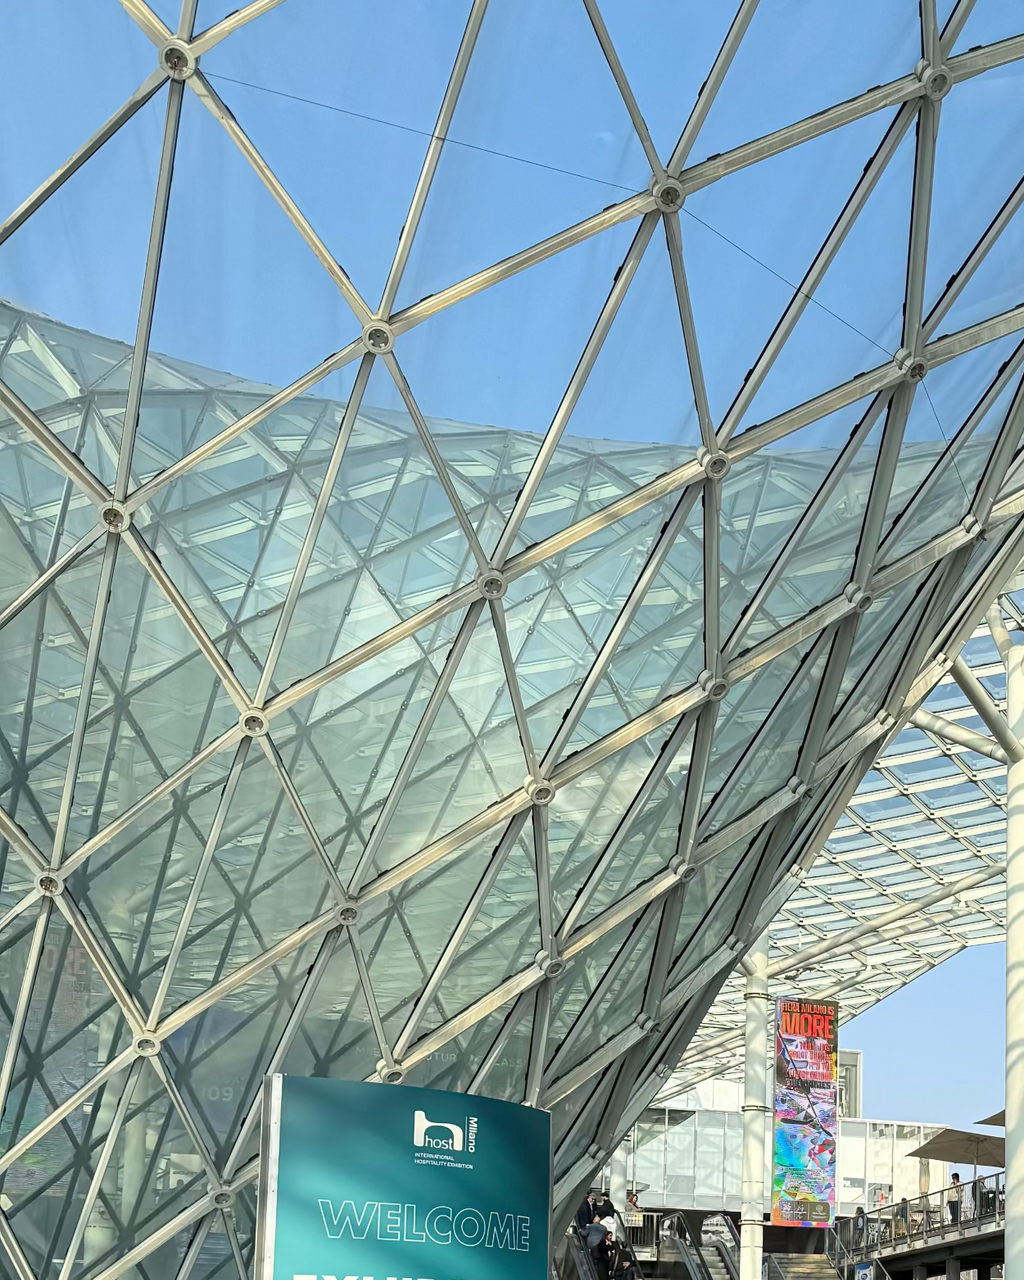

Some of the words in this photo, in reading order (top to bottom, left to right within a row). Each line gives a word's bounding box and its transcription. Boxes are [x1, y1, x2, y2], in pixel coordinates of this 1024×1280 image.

[801, 1004, 826, 1014] MILANO
[781, 1012, 834, 1039] MORE
[468, 1117, 478, 1152] Milano
[425, 1135, 453, 1150] host
[414, 1152, 455, 1161] INTERNATIONAL
[414, 1159, 446, 1167] HOSPITALITY
[318, 1199, 531, 1252] WELCOME
